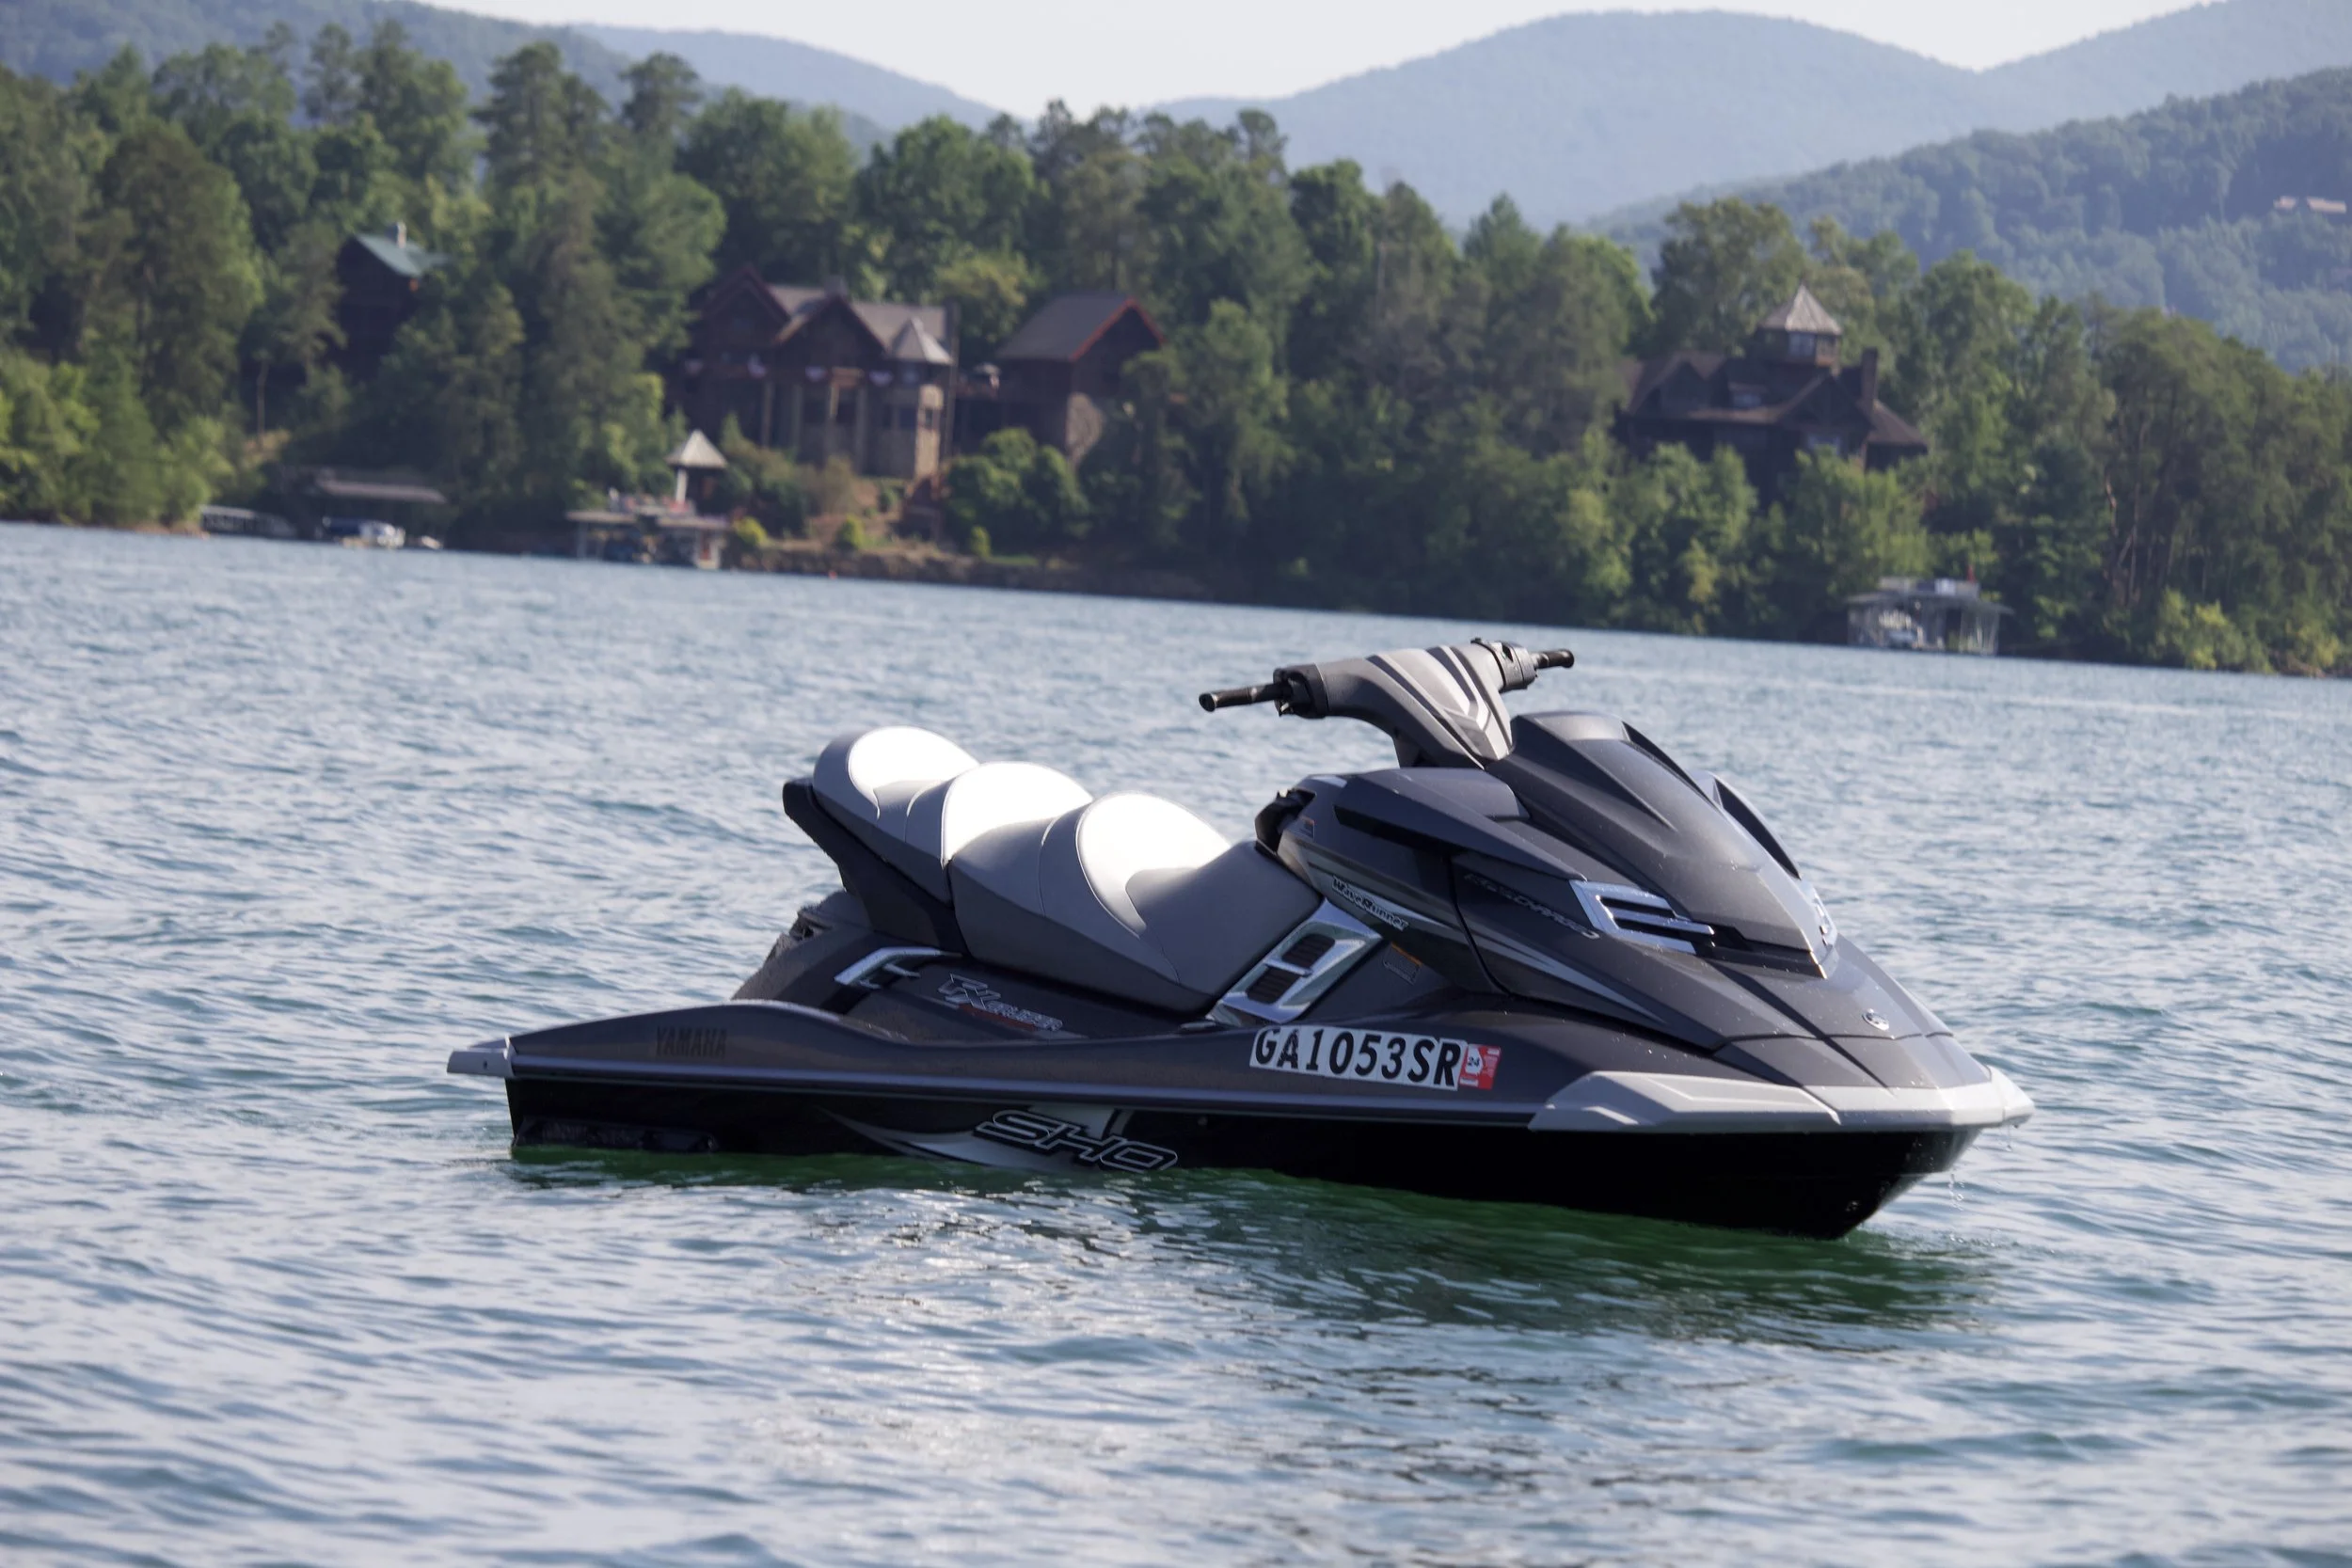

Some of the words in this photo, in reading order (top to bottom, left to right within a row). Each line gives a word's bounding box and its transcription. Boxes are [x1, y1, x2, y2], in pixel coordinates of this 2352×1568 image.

[1331, 875, 1409, 931] WaveRunner
[656, 1024, 727, 1058] YAMAHA
[1255, 1028, 1462, 1086] GA1053SR
[976, 1109, 1178, 1174] SHO
